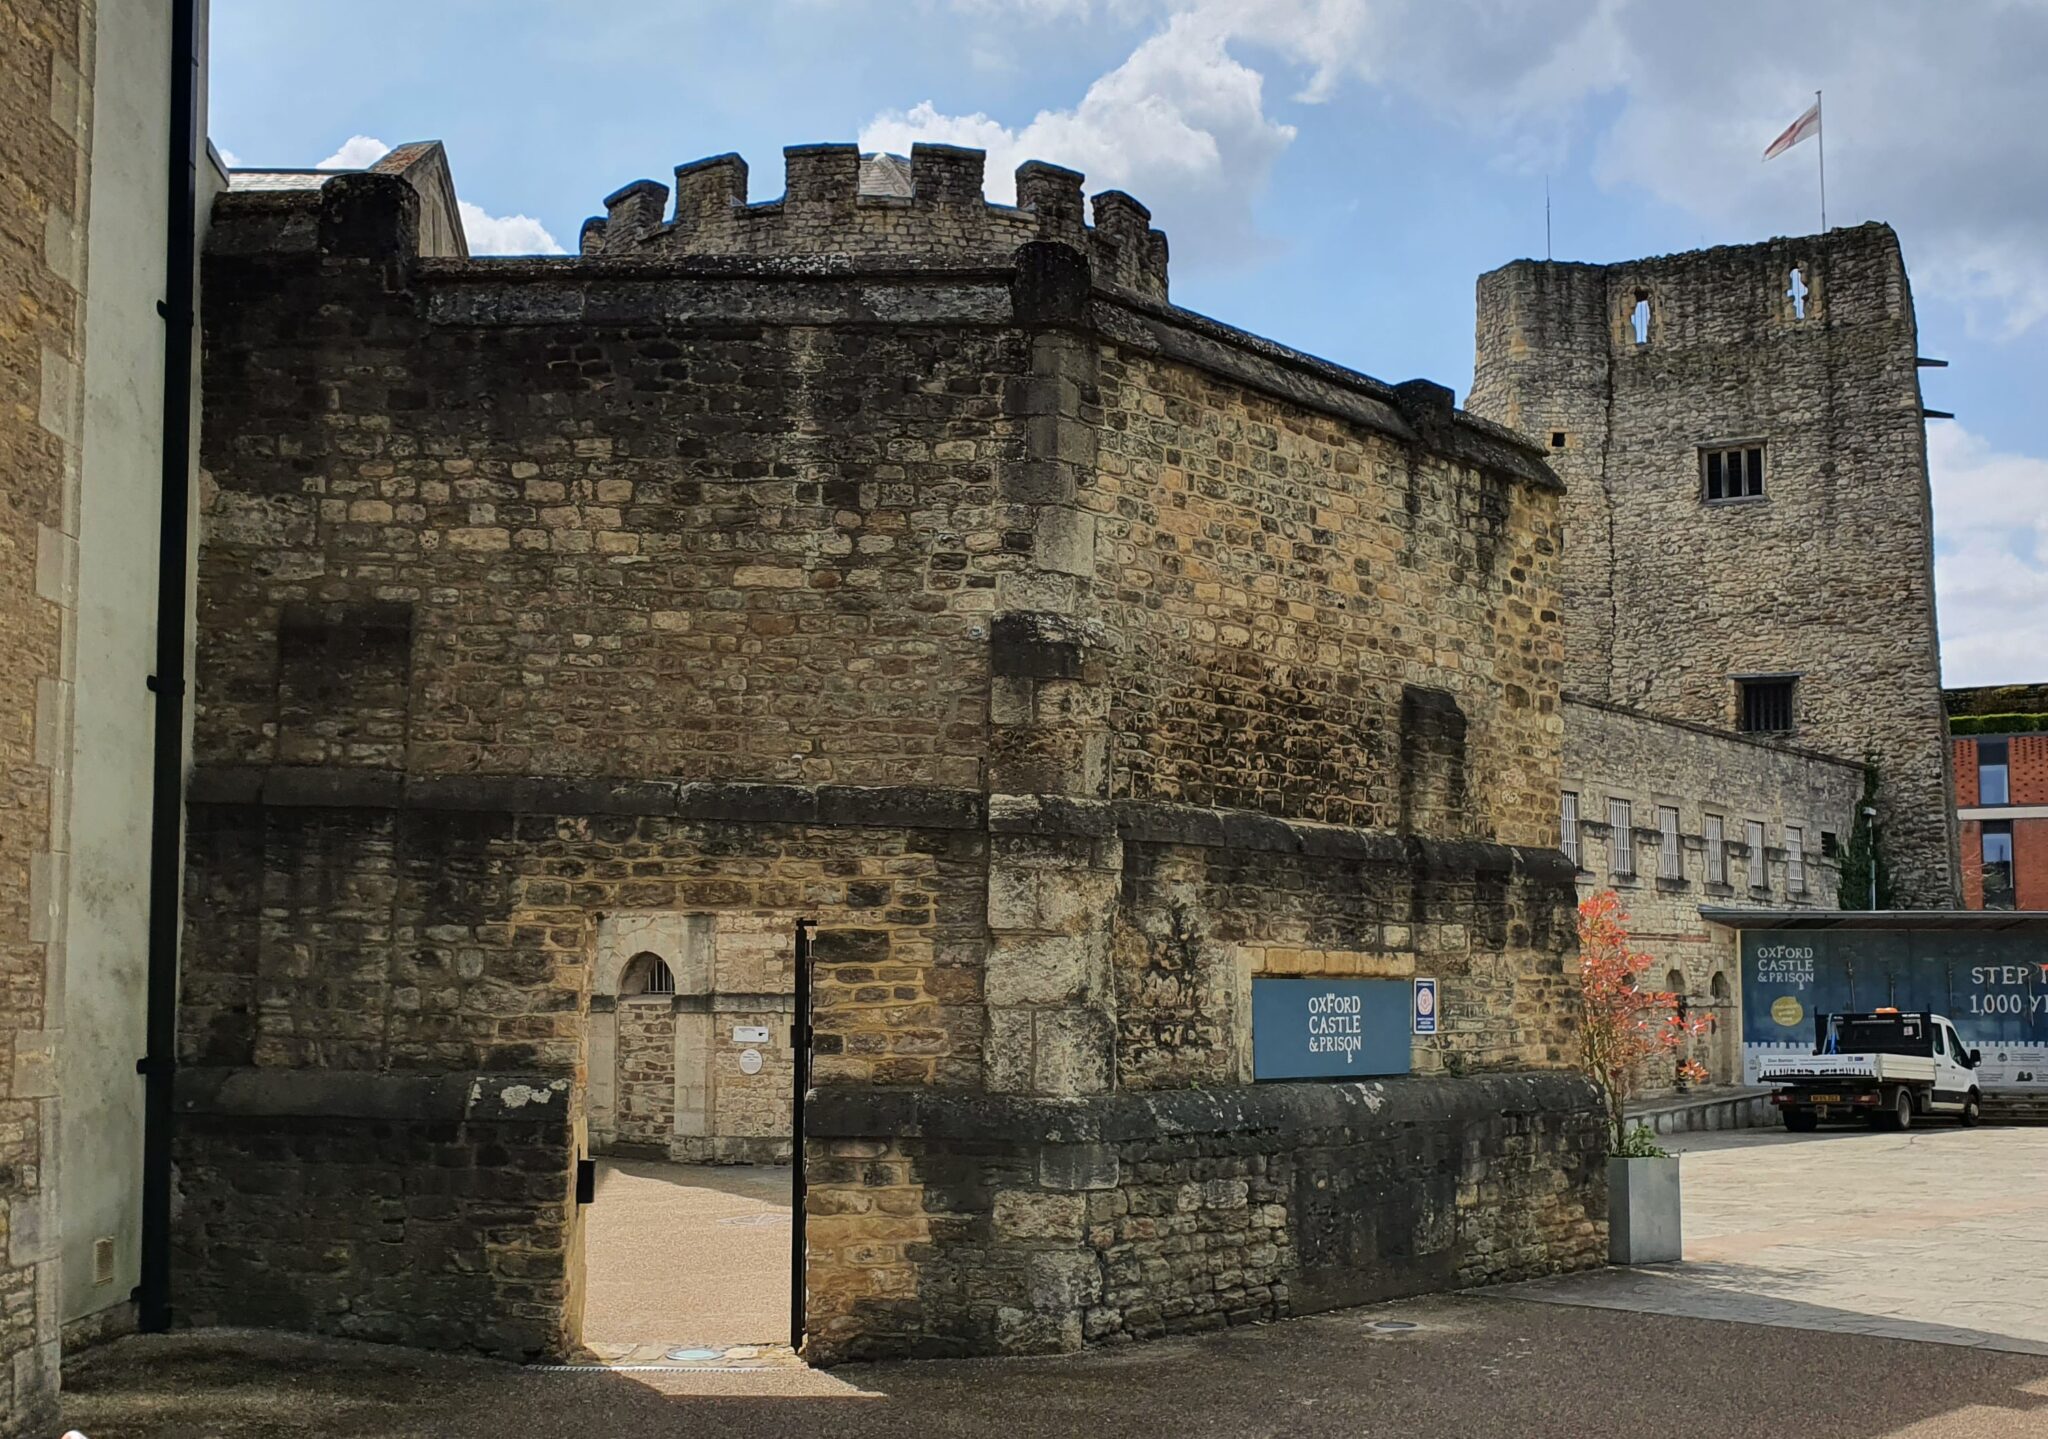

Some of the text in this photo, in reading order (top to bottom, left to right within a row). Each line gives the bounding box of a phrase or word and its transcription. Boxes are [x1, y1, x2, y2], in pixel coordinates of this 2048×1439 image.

[1757, 945, 1813, 958] OXFORD
[1758, 959, 1814, 972] CASTLE
[1971, 965, 2029, 985] STEP
[1308, 993, 1361, 1014] OXFORD
[1969, 994, 2022, 1016] 1,000
[1308, 1015, 1361, 1034] CASTLE
